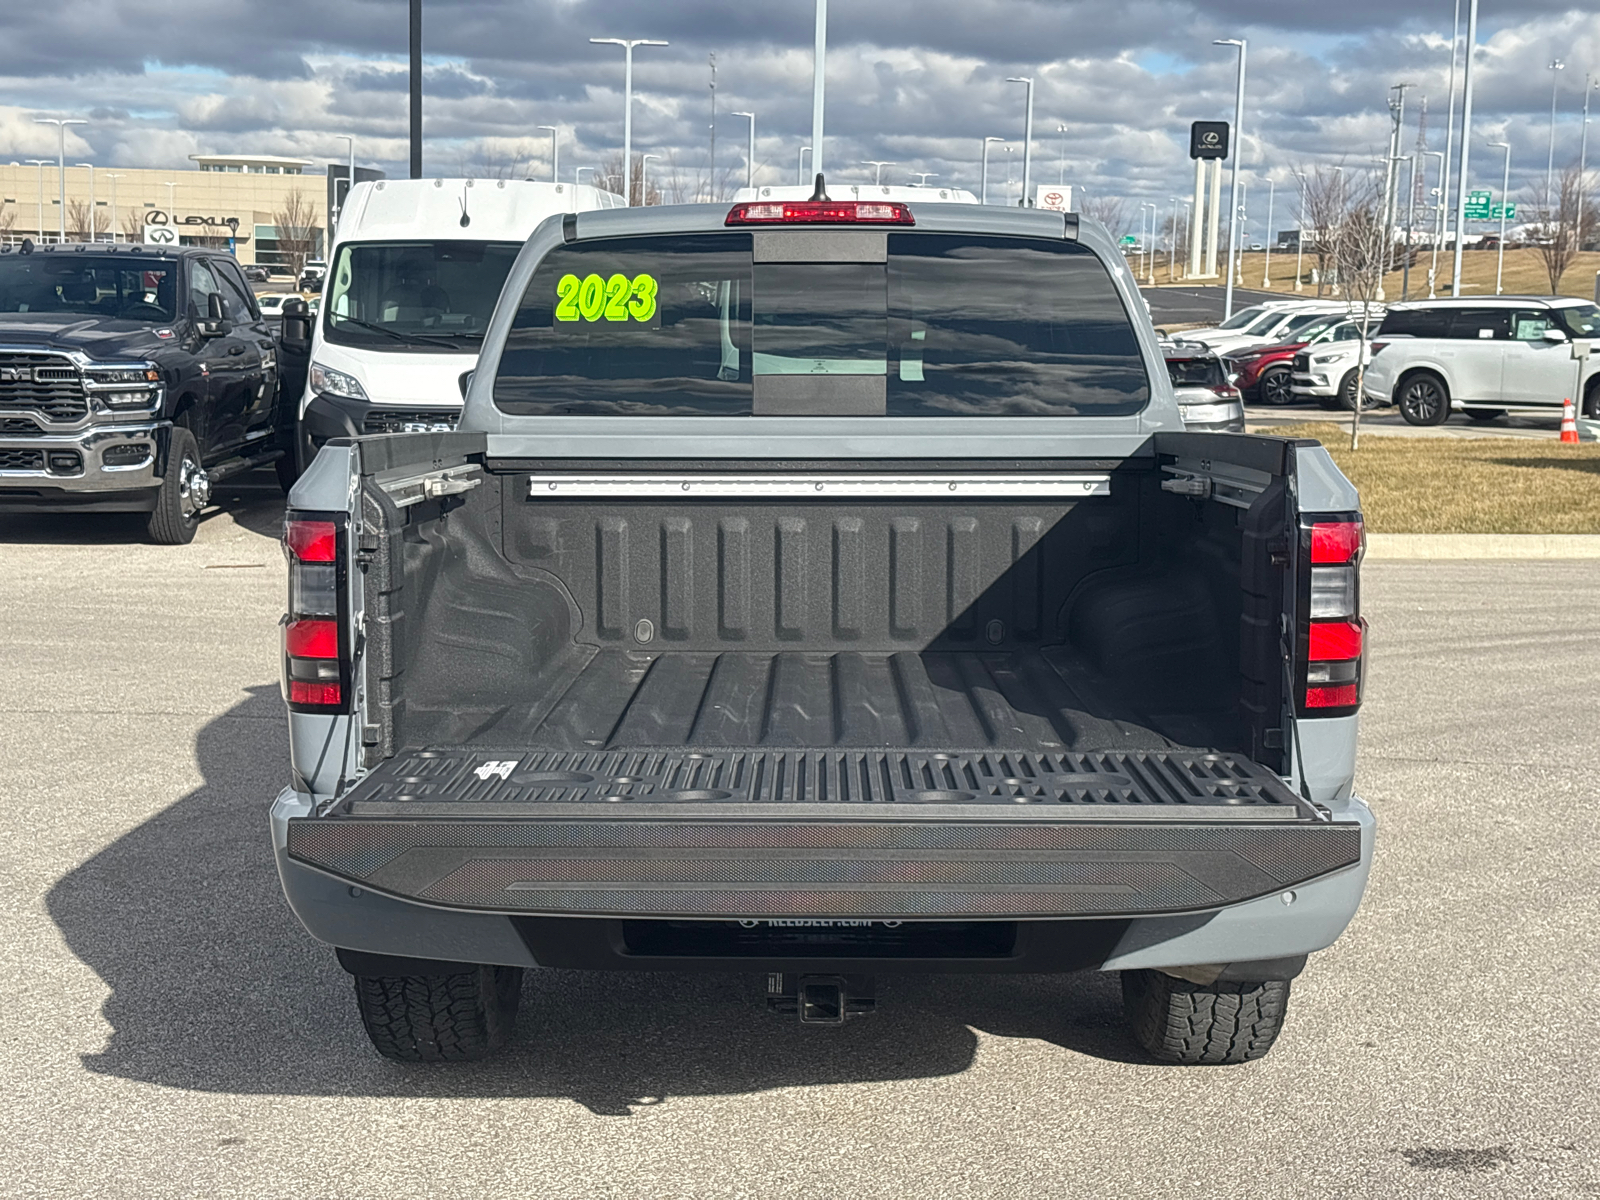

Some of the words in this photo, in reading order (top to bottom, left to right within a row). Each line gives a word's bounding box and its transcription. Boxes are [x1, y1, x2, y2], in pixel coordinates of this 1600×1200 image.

[173, 214, 239, 226] LEXU
[556, 273, 658, 322] 2023
[404, 422, 459, 432] RA
